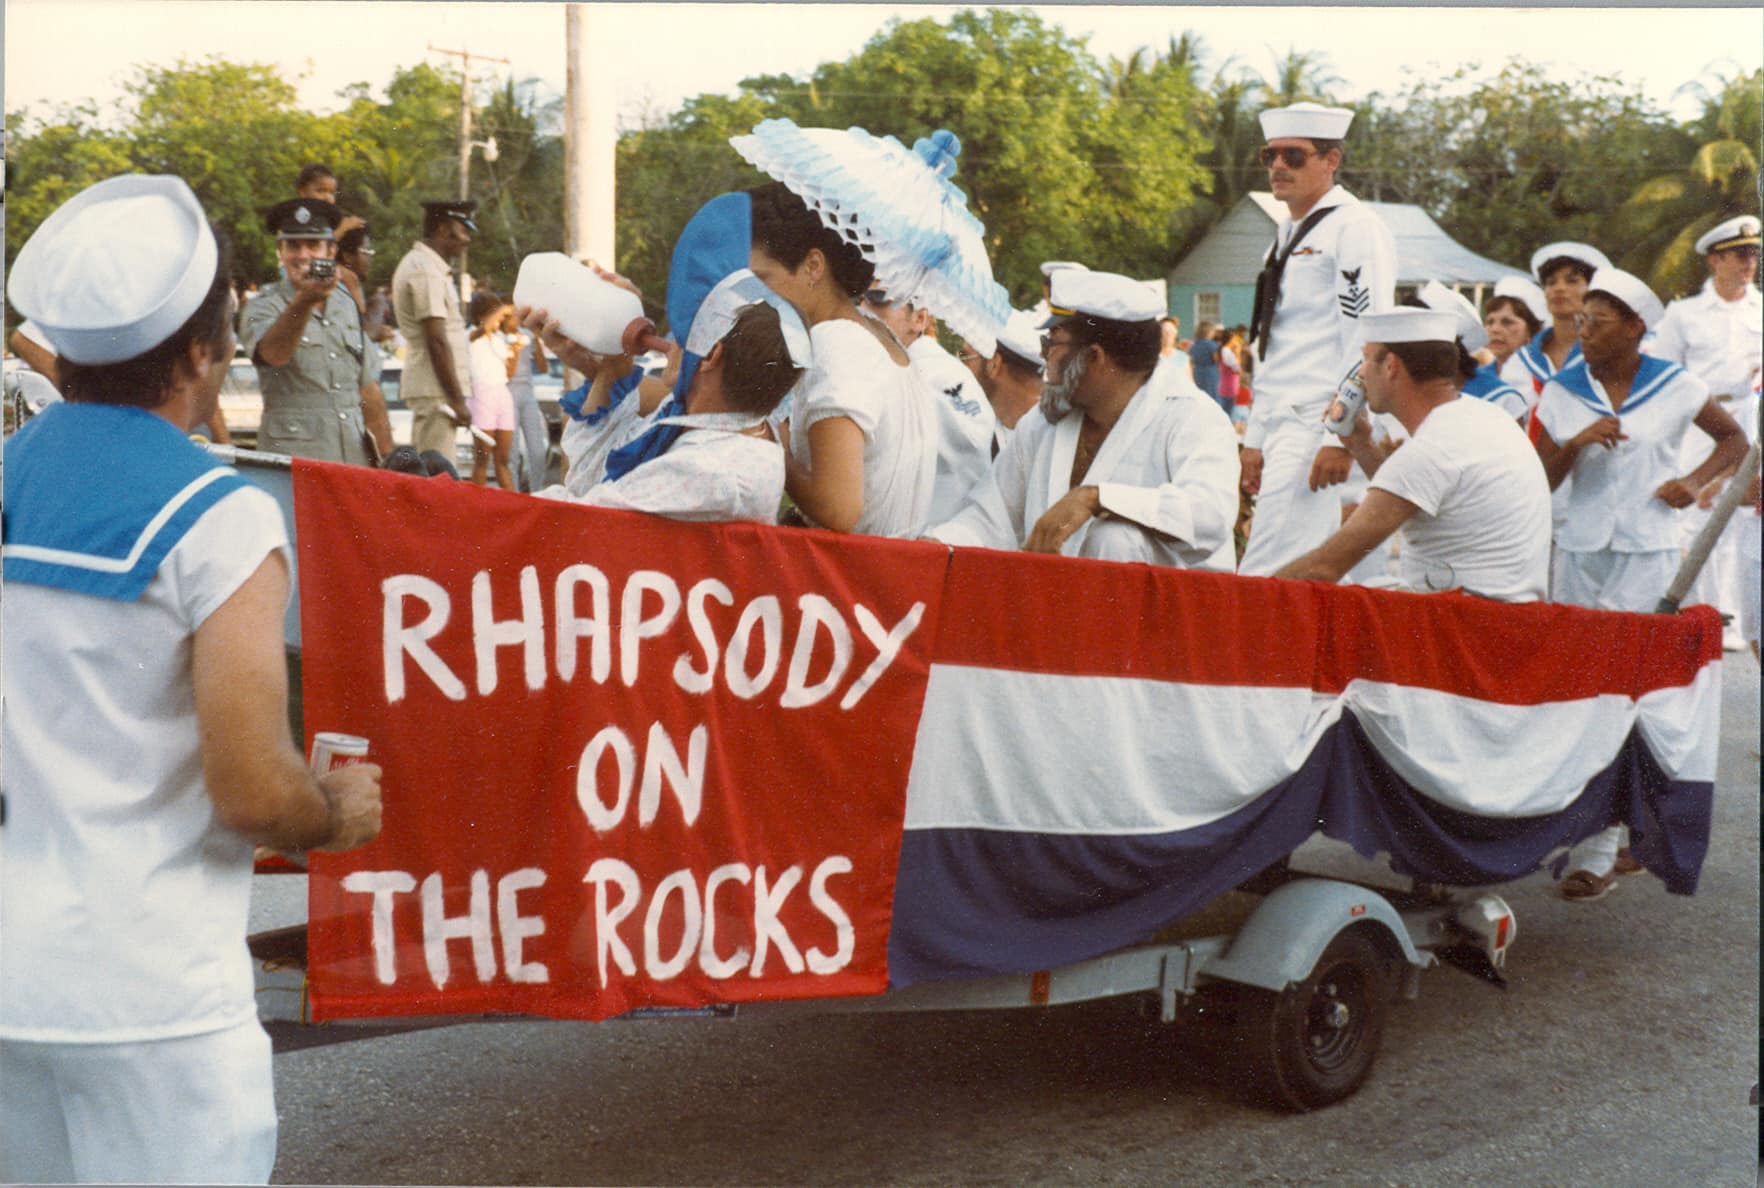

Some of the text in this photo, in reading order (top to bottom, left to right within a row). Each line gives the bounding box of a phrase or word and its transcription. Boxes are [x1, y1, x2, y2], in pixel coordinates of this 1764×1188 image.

[382, 564, 926, 710] RHAPSODY
[577, 721, 708, 831] ON
[342, 856, 855, 990] THE ROCKS
